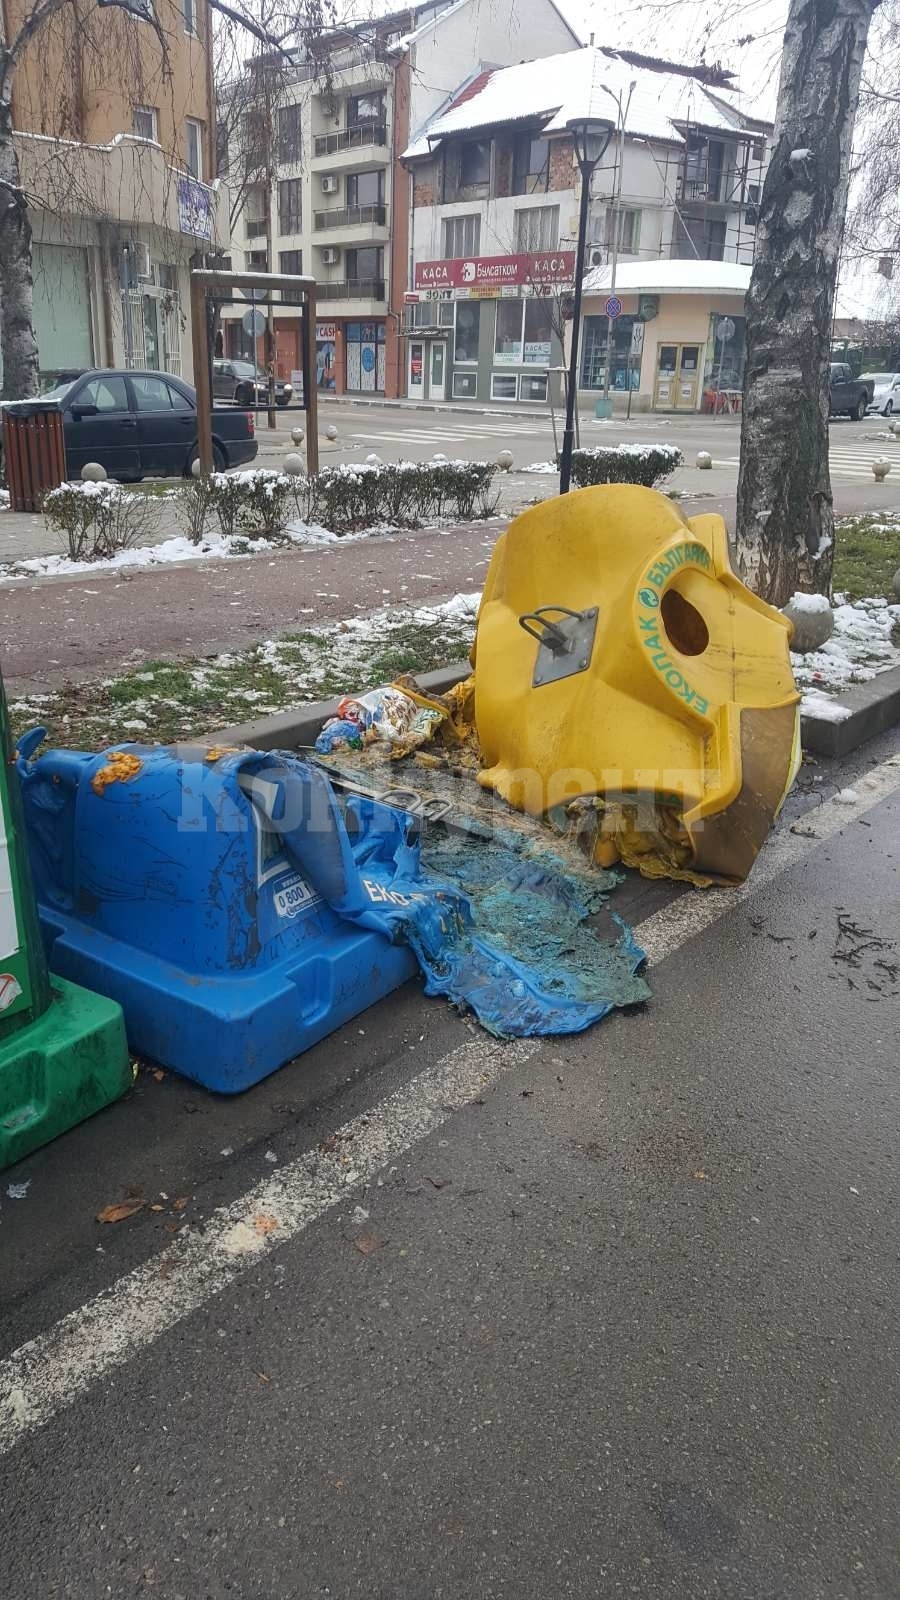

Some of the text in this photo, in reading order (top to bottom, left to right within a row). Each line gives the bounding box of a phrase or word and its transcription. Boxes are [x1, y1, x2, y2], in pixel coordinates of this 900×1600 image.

[534, 258, 565, 272] КАСА
[422, 266, 448, 279] КАСА
[639, 542, 712, 715] ЕКОПАК БЪЛГАРИЯ
